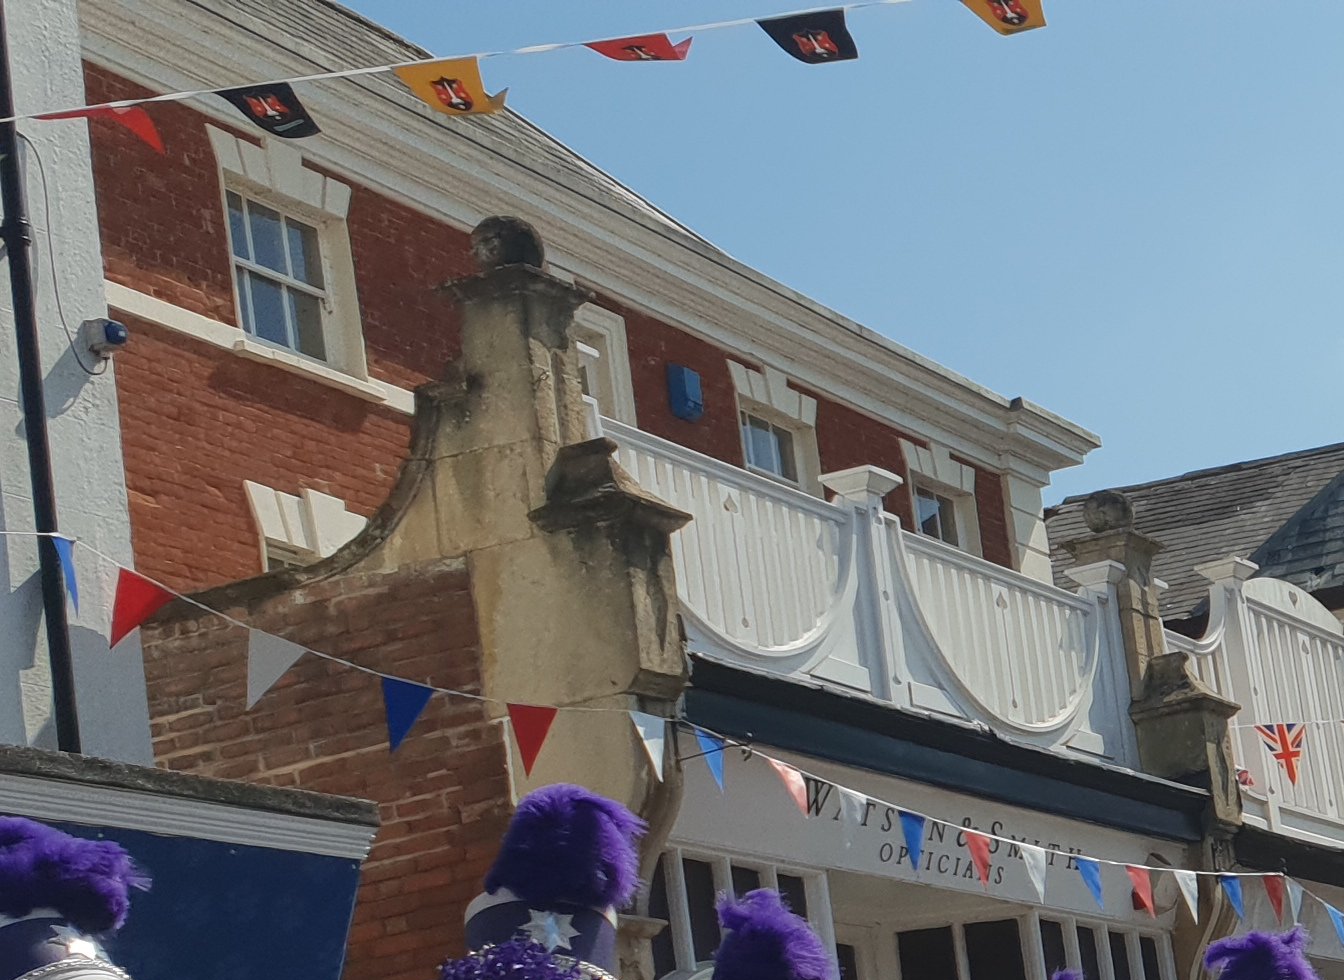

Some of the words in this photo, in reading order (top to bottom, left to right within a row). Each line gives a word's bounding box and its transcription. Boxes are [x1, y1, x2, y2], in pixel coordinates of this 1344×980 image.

[804, 776, 949, 844] WTSN
[956, 816, 979, 848] &
[988, 820, 1084, 871] SMTH
[879, 842, 1005, 885] OPICIAS
